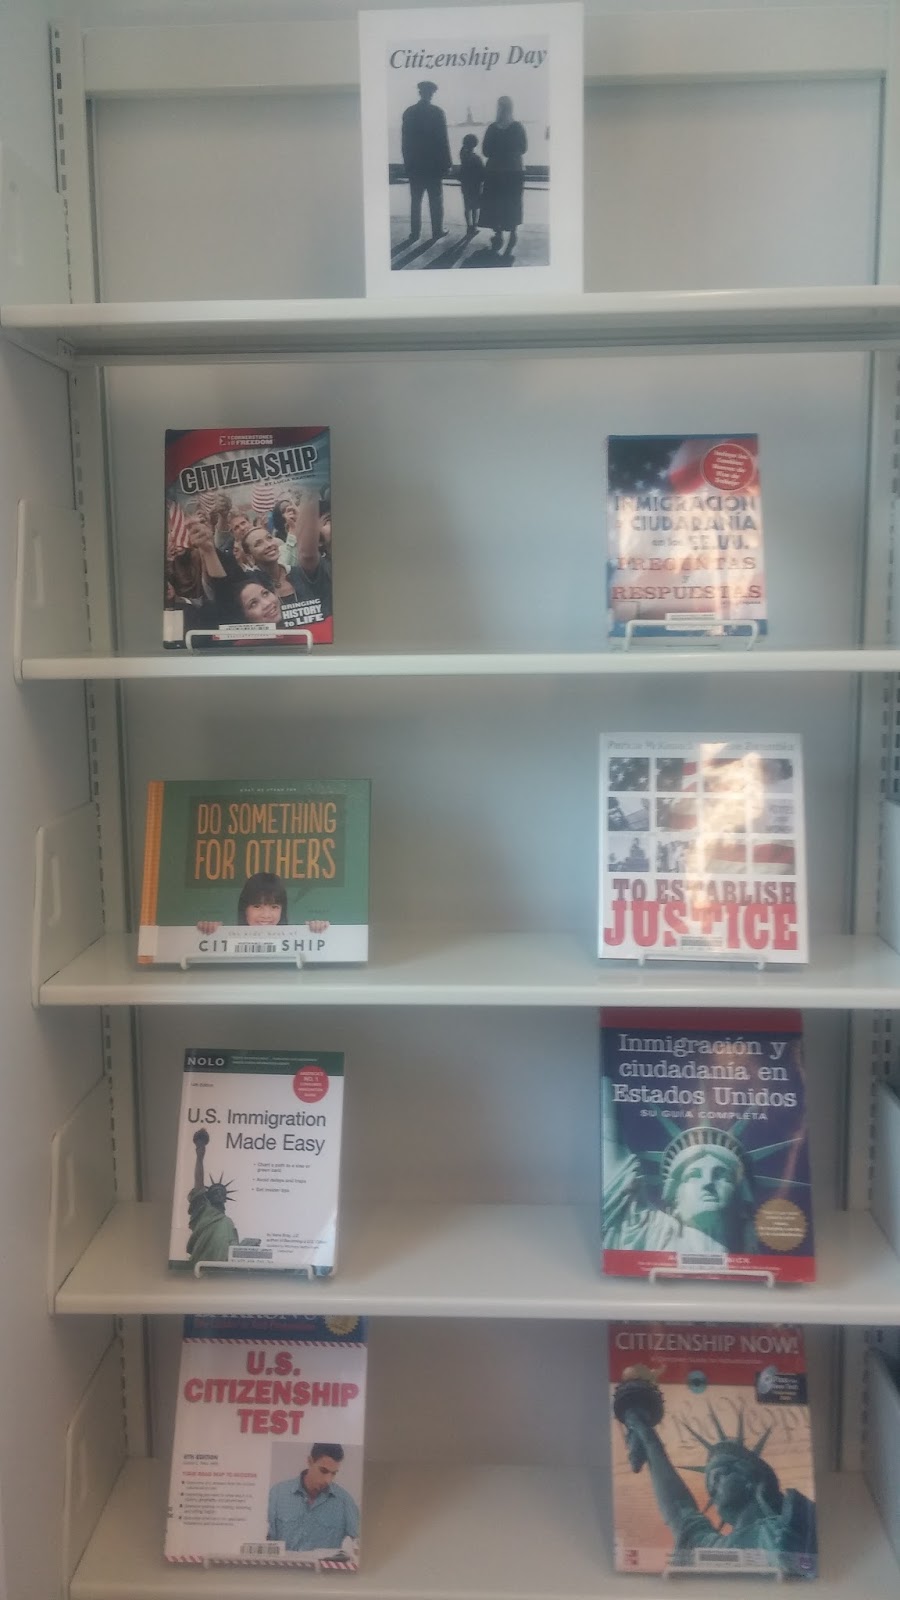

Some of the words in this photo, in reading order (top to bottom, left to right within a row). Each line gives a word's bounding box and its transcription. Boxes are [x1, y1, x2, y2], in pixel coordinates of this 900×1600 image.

[390, 46, 500, 71] Citizenship
[506, 45, 548, 69] Day
[180, 445, 318, 494] CITIZENSHIP
[281, 598, 321, 610] BRINGING
[612, 585, 762, 600] RESPUESTAS
[282, 604, 322, 619] HISTORY
[296, 613, 325, 626] LIFE
[197, 803, 222, 834] DO
[228, 802, 337, 835] SOMETHING
[194, 838, 236, 880] FOR
[245, 838, 337, 879] OTHERS
[612, 878, 647, 901] TO
[655, 879, 797, 906] ESTABLISH
[603, 900, 798, 950] JUSTICE
[199, 939, 326, 952] CITSHIP
[618, 1033, 763, 1057] Inmigración
[770, 1041, 787, 1060] y
[187, 1056, 225, 1067] NOLO
[619, 1060, 751, 1080] ciudadanía
[757, 1066, 789, 1081] en
[612, 1084, 706, 1105] Estados
[712, 1087, 797, 1108] Unidos
[187, 1107, 221, 1124] U.S.
[227, 1109, 326, 1129] Immigration
[698, 1111, 768, 1121] COMPLETA
[225, 1132, 277, 1150] Made
[283, 1133, 326, 1156] Easy
[615, 1331, 736, 1352] CITIZENSHIP
[741, 1335, 800, 1354] NOW!
[246, 1351, 301, 1376] U.S.
[183, 1378, 360, 1407] CITIZENSHIP
[237, 1408, 304, 1435] TEST
